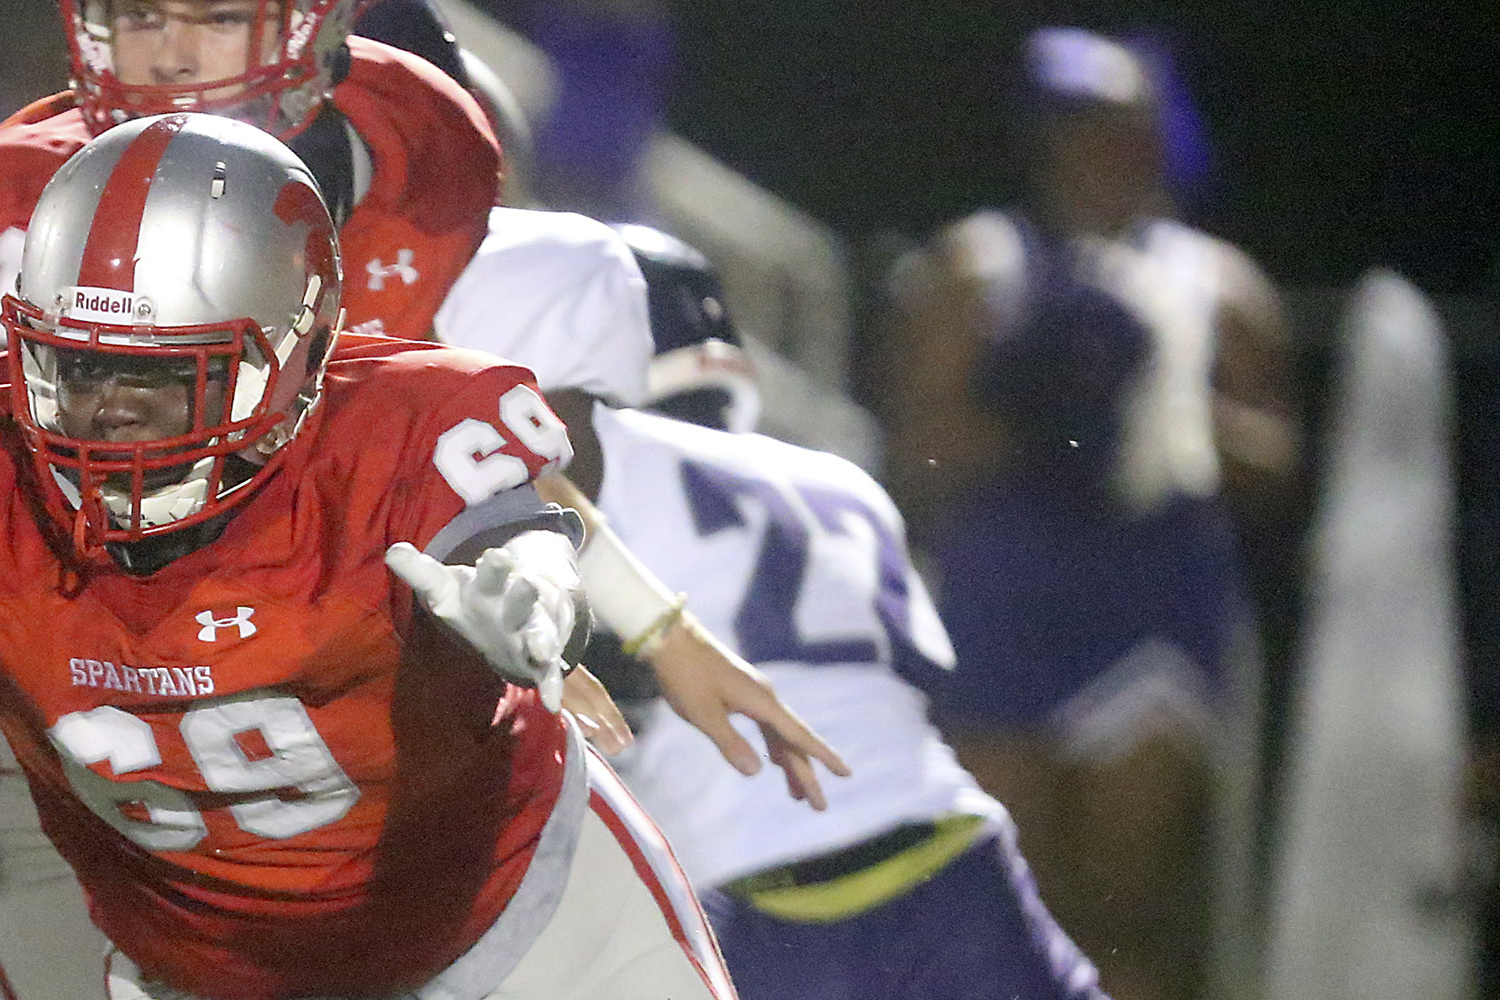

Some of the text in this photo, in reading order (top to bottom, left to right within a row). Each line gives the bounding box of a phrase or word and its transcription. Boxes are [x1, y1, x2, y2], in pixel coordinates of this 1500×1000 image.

[75, 292, 132, 314] Riddell
[433, 383, 575, 504] 69
[69, 658, 215, 696] SPARTANS
[47, 697, 361, 850] 69
